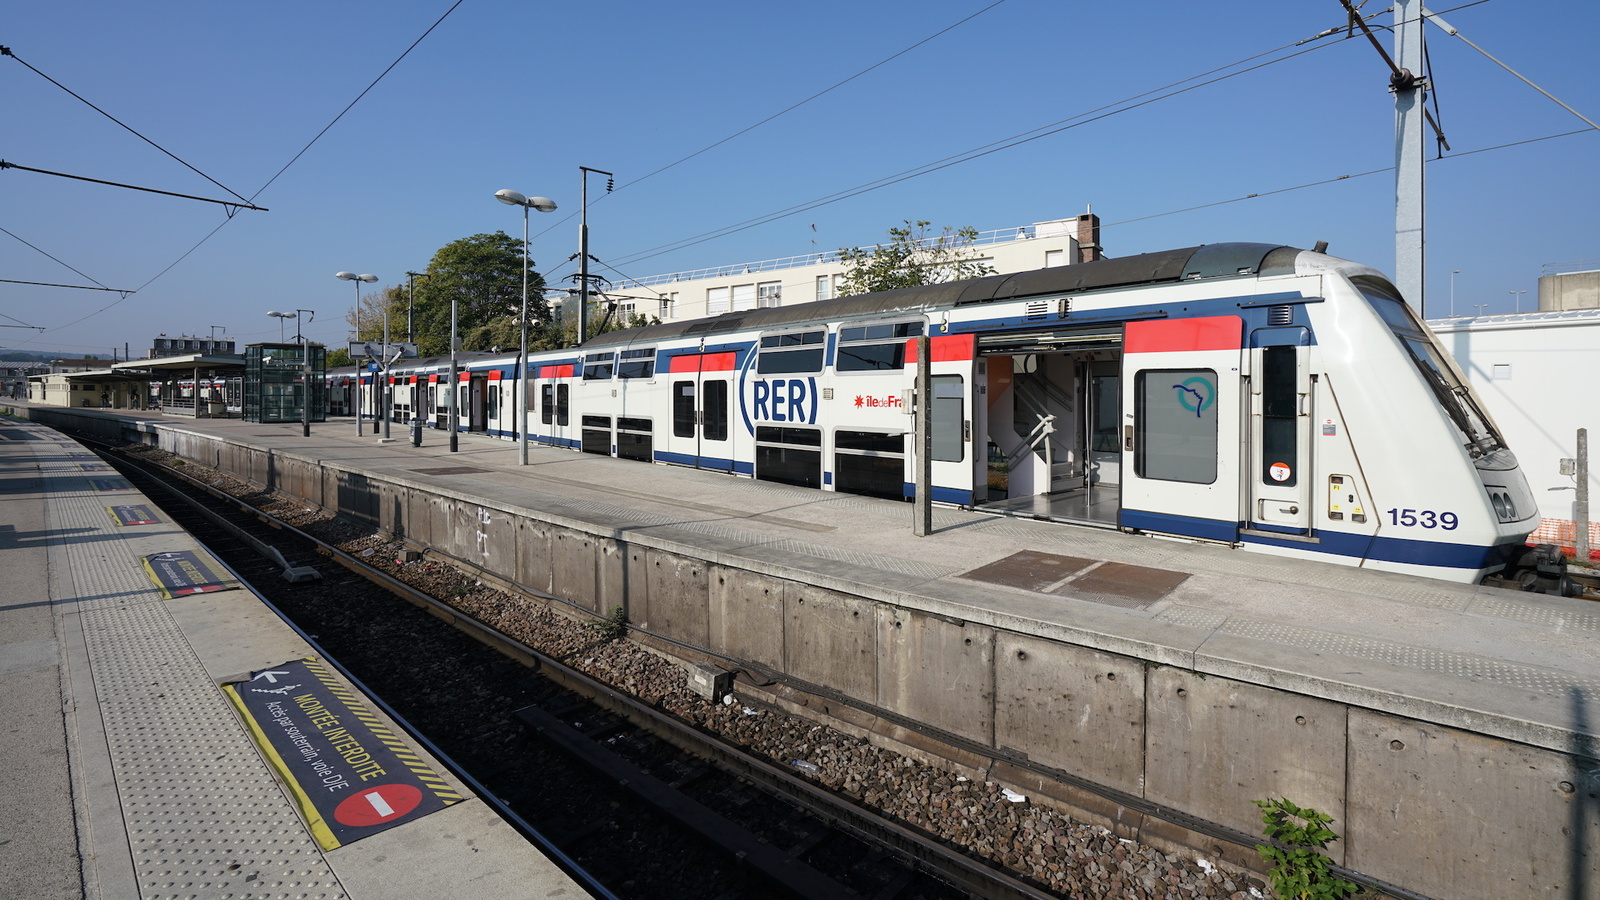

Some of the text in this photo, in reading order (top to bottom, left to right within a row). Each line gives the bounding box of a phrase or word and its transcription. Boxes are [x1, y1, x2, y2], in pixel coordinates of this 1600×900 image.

[754, 379, 806, 422] RER
[1387, 508, 1459, 531] 1539
[265, 700, 288, 718] Accès
[273, 717, 294, 727] par
[284, 726, 321, 762] souterrain,
[293, 694, 387, 781] MONTÉE INTERDITE
[311, 759, 335, 777] voie
